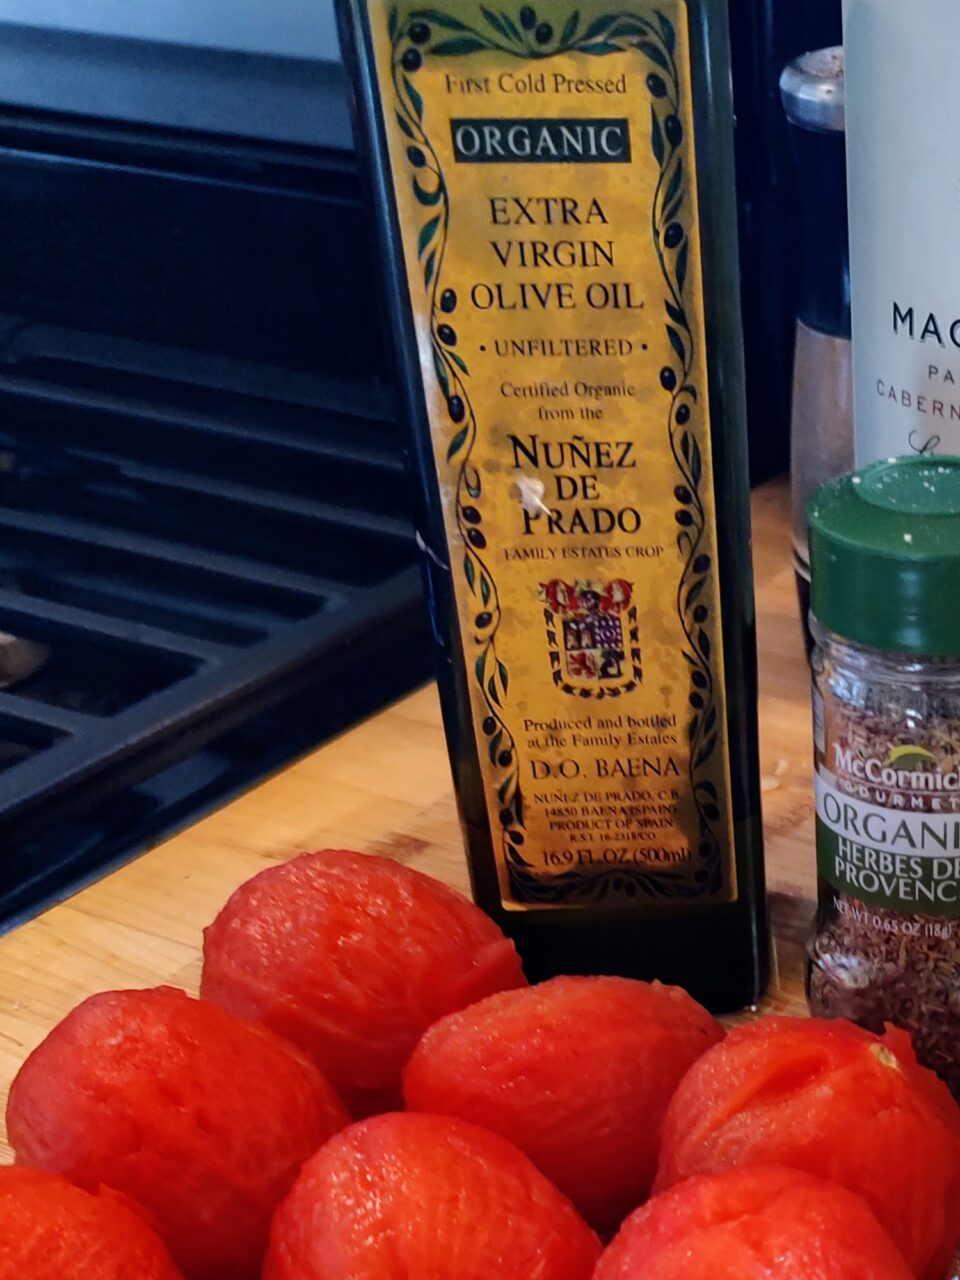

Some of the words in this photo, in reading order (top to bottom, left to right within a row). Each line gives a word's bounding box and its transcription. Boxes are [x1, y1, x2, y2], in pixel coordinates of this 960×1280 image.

[445, 74, 490, 94] First
[498, 73, 546, 94] Cold
[554, 74, 627, 94] Pressed
[455, 125, 623, 156] ORGANIC
[489, 197, 609, 225] EXTRA
[489, 240, 615, 267] VIRGIN
[470, 283, 576, 310] OLIVE
[586, 283, 645, 309] OIL
[495, 339, 633, 356] UNFILTERED
[500, 381, 568, 398] Certified
[575, 382, 635, 400] Organic
[538, 406, 574, 420] from
[580, 406, 603, 420] the
[507, 434, 636, 469] NUÑEZ
[555, 475, 600, 501] DE
[522, 506, 641, 535] PRADO
[504, 547, 557, 561] FAMILY
[626, 546, 664, 558] CROP
[523, 715, 592, 732] Produced
[597, 715, 623, 729] and
[627, 714, 677, 729] bottled
[528, 738, 540, 748] at
[545, 734, 566, 747] the
[572, 733, 622, 748] Family
[627, 733, 678, 745] Estates
[530, 759, 587, 779] D.O.
[596, 756, 680, 778] BAENA
[550, 819, 611, 831] PRODUCT
[615, 818, 631, 828] OF
[636, 818, 674, 829] SPAIN
[838, 837, 922, 878] HERBES
[851, 907, 870, 925] WT
[872, 916, 898, 934] 0.65
[902, 922, 921, 937] OZ
